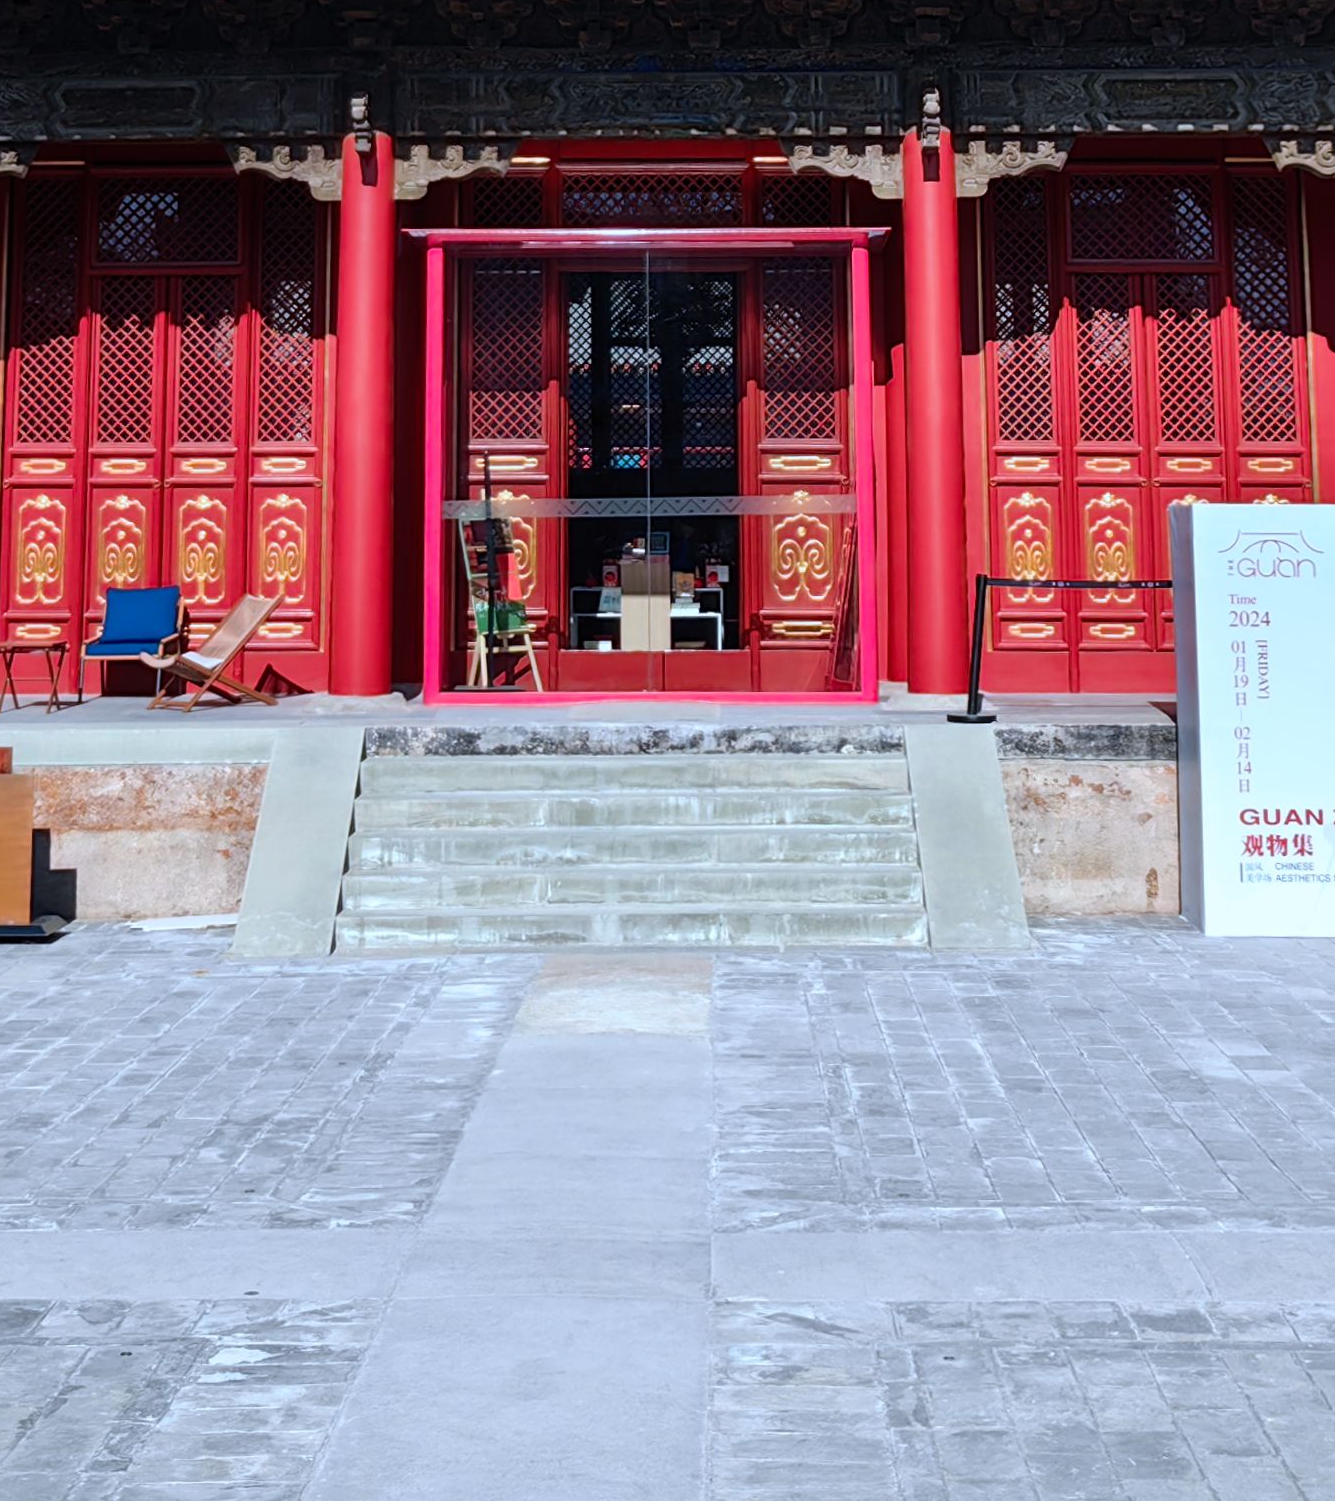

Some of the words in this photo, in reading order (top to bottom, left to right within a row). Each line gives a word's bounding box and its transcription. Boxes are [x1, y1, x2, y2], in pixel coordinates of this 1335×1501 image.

[1227, 594, 1257, 605] Time
[1228, 610, 1272, 627] 2024
[1239, 808, 1324, 826] GUAN
[1241, 833, 1314, 857] 观物集
[1274, 862, 1314, 871] CHINESE
[1275, 873, 1332, 883] AESTHETICS
